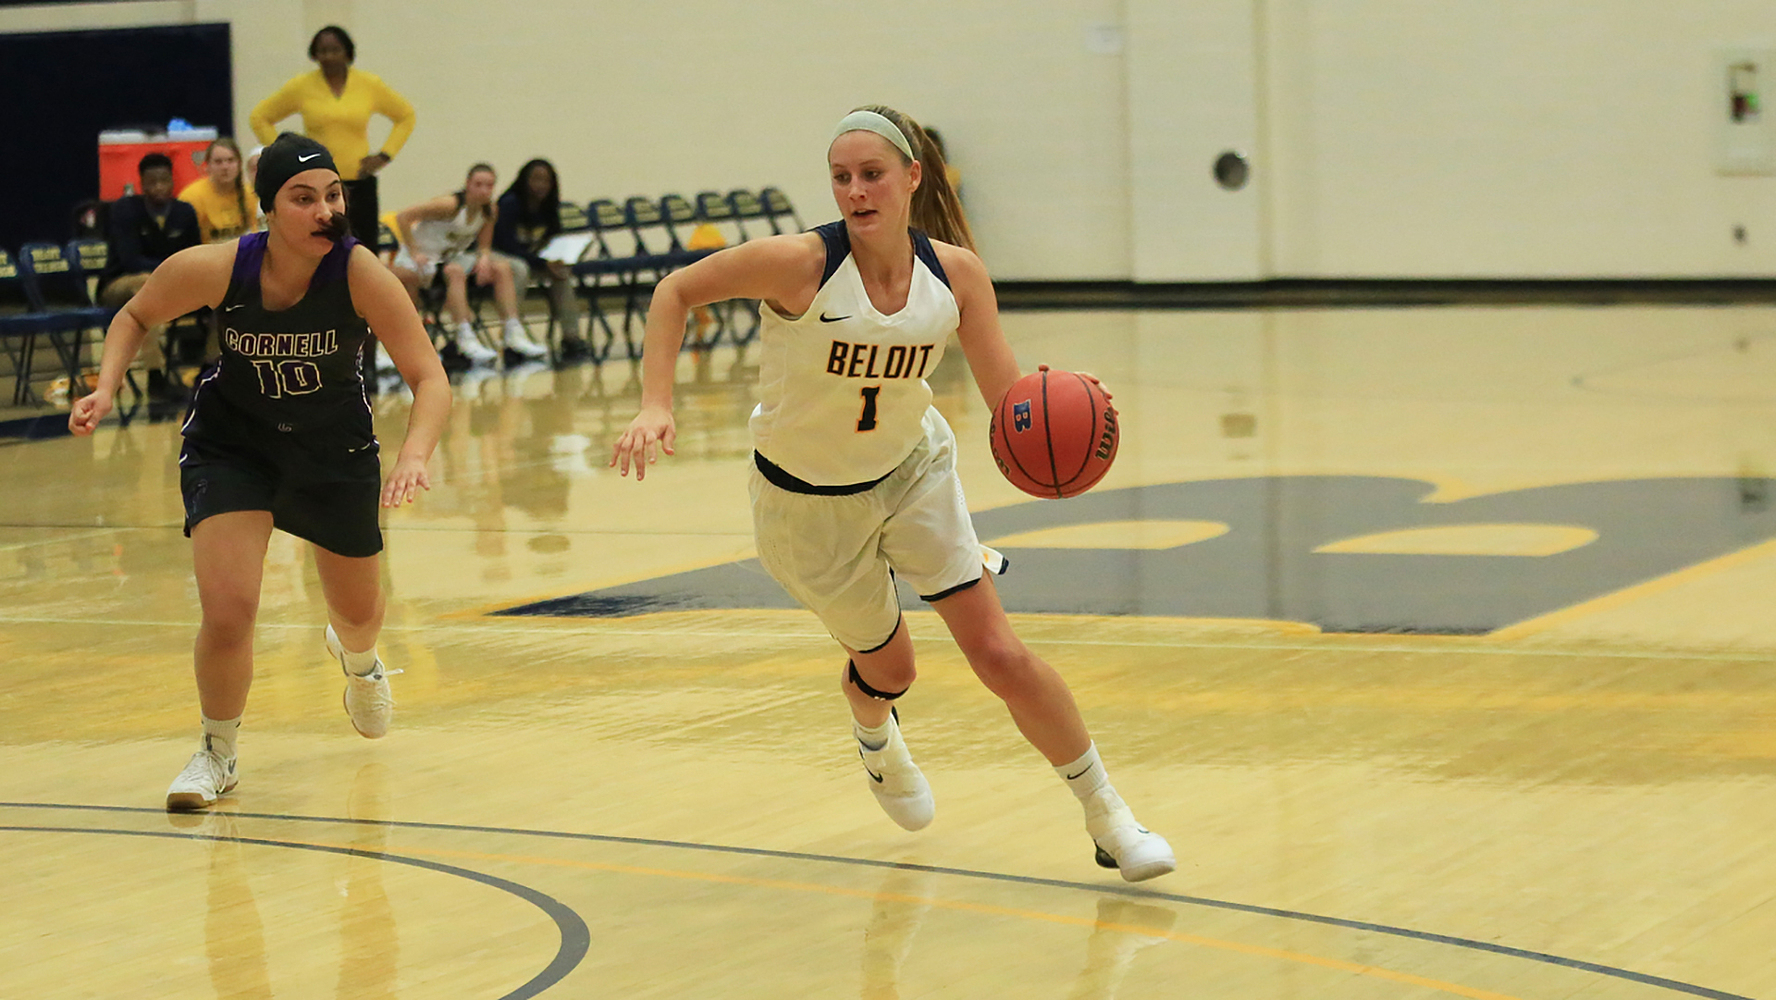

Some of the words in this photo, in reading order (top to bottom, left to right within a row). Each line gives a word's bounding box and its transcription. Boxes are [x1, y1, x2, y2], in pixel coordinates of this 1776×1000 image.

[225, 328, 338, 357] CORNELL
[826, 339, 935, 379] BELOIT
[251, 360, 323, 399] 10
[855, 384, 881, 433] 1
[1013, 398, 1032, 434] B
